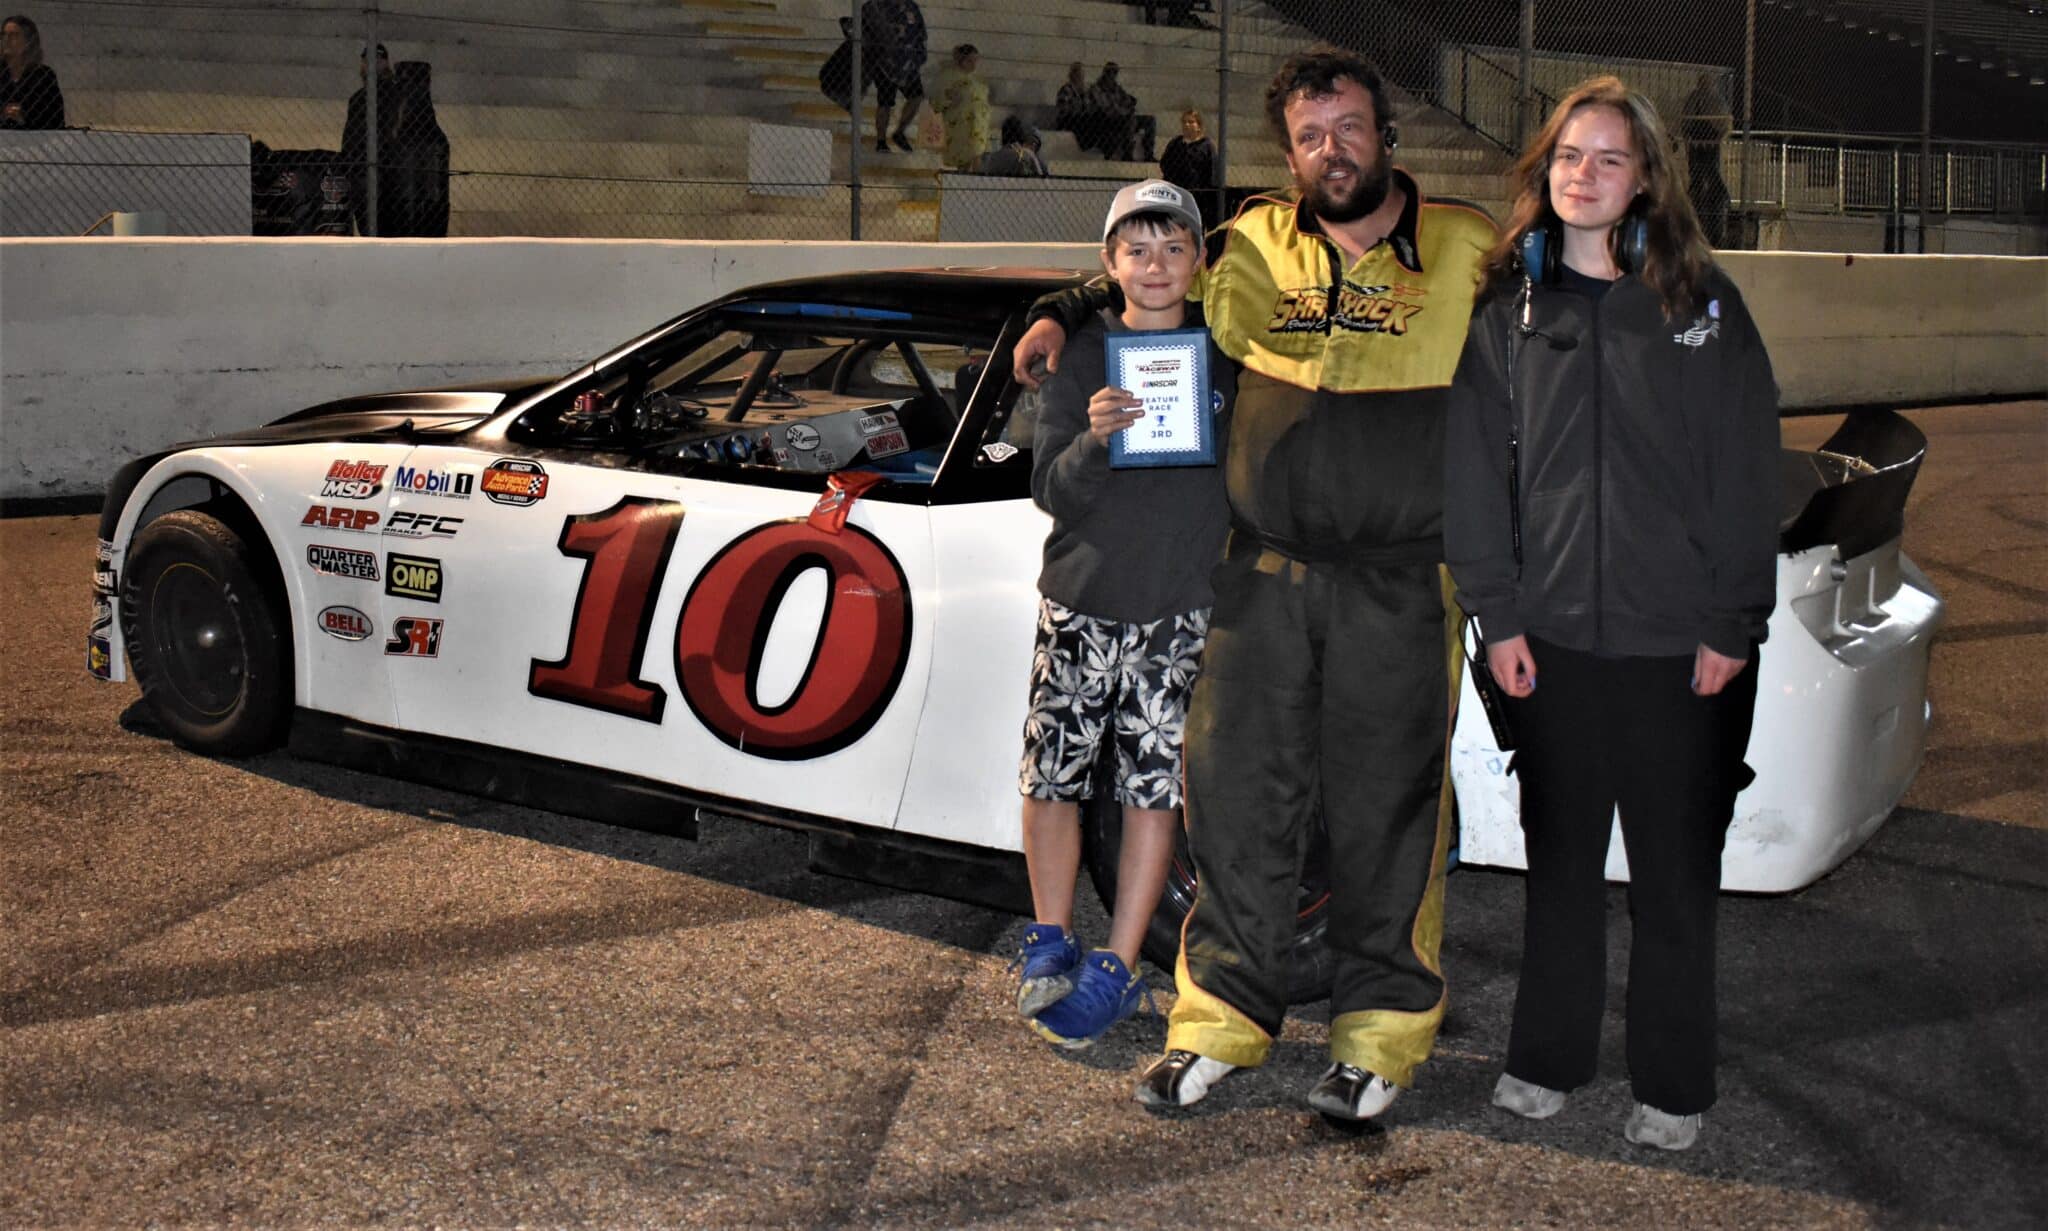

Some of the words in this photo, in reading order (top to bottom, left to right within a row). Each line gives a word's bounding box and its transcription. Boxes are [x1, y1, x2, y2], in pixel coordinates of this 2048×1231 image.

[1142, 395, 1180, 404] EATURE
[1151, 430, 1173, 438] 3RD
[325, 459, 388, 485] Holley
[395, 465, 451, 493] Mobil
[456, 473, 473, 495] 1
[493, 472, 530, 484] Advance
[321, 479, 383, 500] MSD
[485, 480, 507, 491] Auto
[506, 482, 529, 493] Parts
[301, 505, 380, 530] ARP
[386, 511, 464, 535] PFC
[383, 527, 423, 536] BRAKES
[309, 547, 374, 566] QUARTER
[320, 560, 377, 579] MASTER
[392, 564, 439, 590] OMP
[325, 611, 366, 633] BELL
[527, 494, 913, 762] 10
